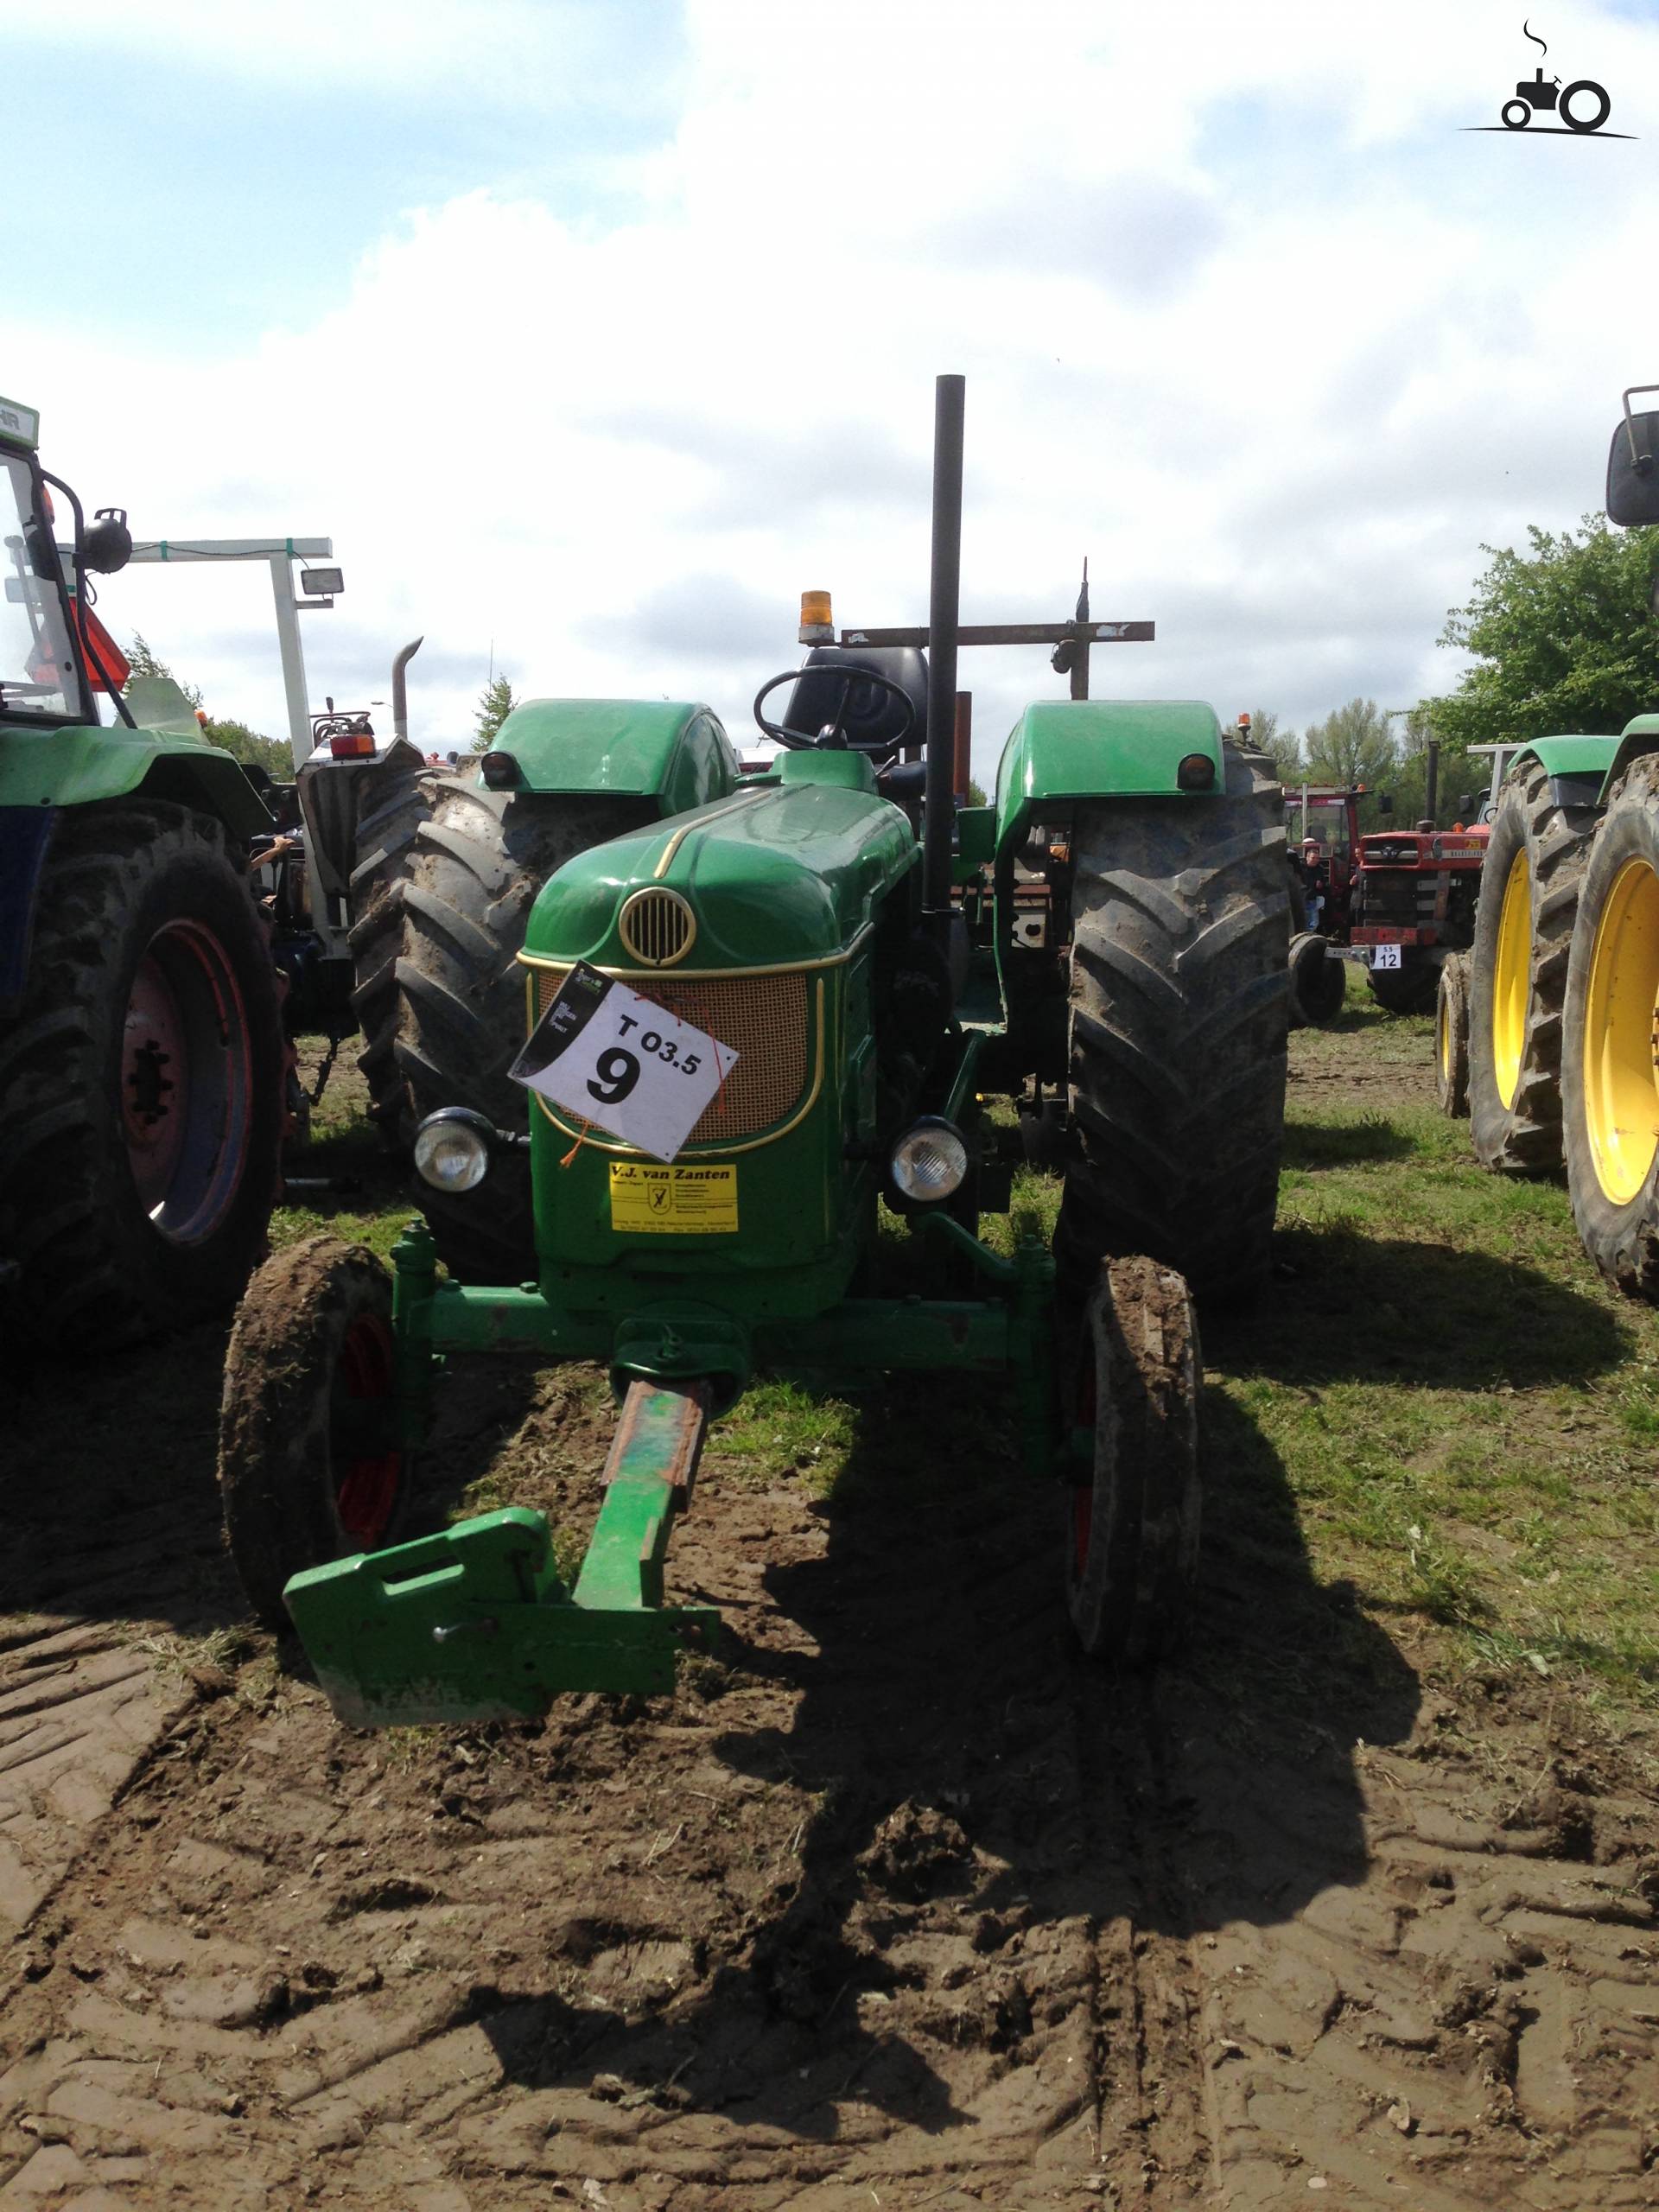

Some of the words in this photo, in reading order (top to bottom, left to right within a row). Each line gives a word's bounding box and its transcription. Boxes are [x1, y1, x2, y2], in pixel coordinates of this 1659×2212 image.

[1380, 954, 1396, 967] 12
[619, 1014, 639, 1037] T
[587, 1046, 641, 1104] 9
[612, 1166, 637, 1178] V.J.
[643, 1170, 670, 1179] van
[674, 1169, 730, 1179] Zanten
